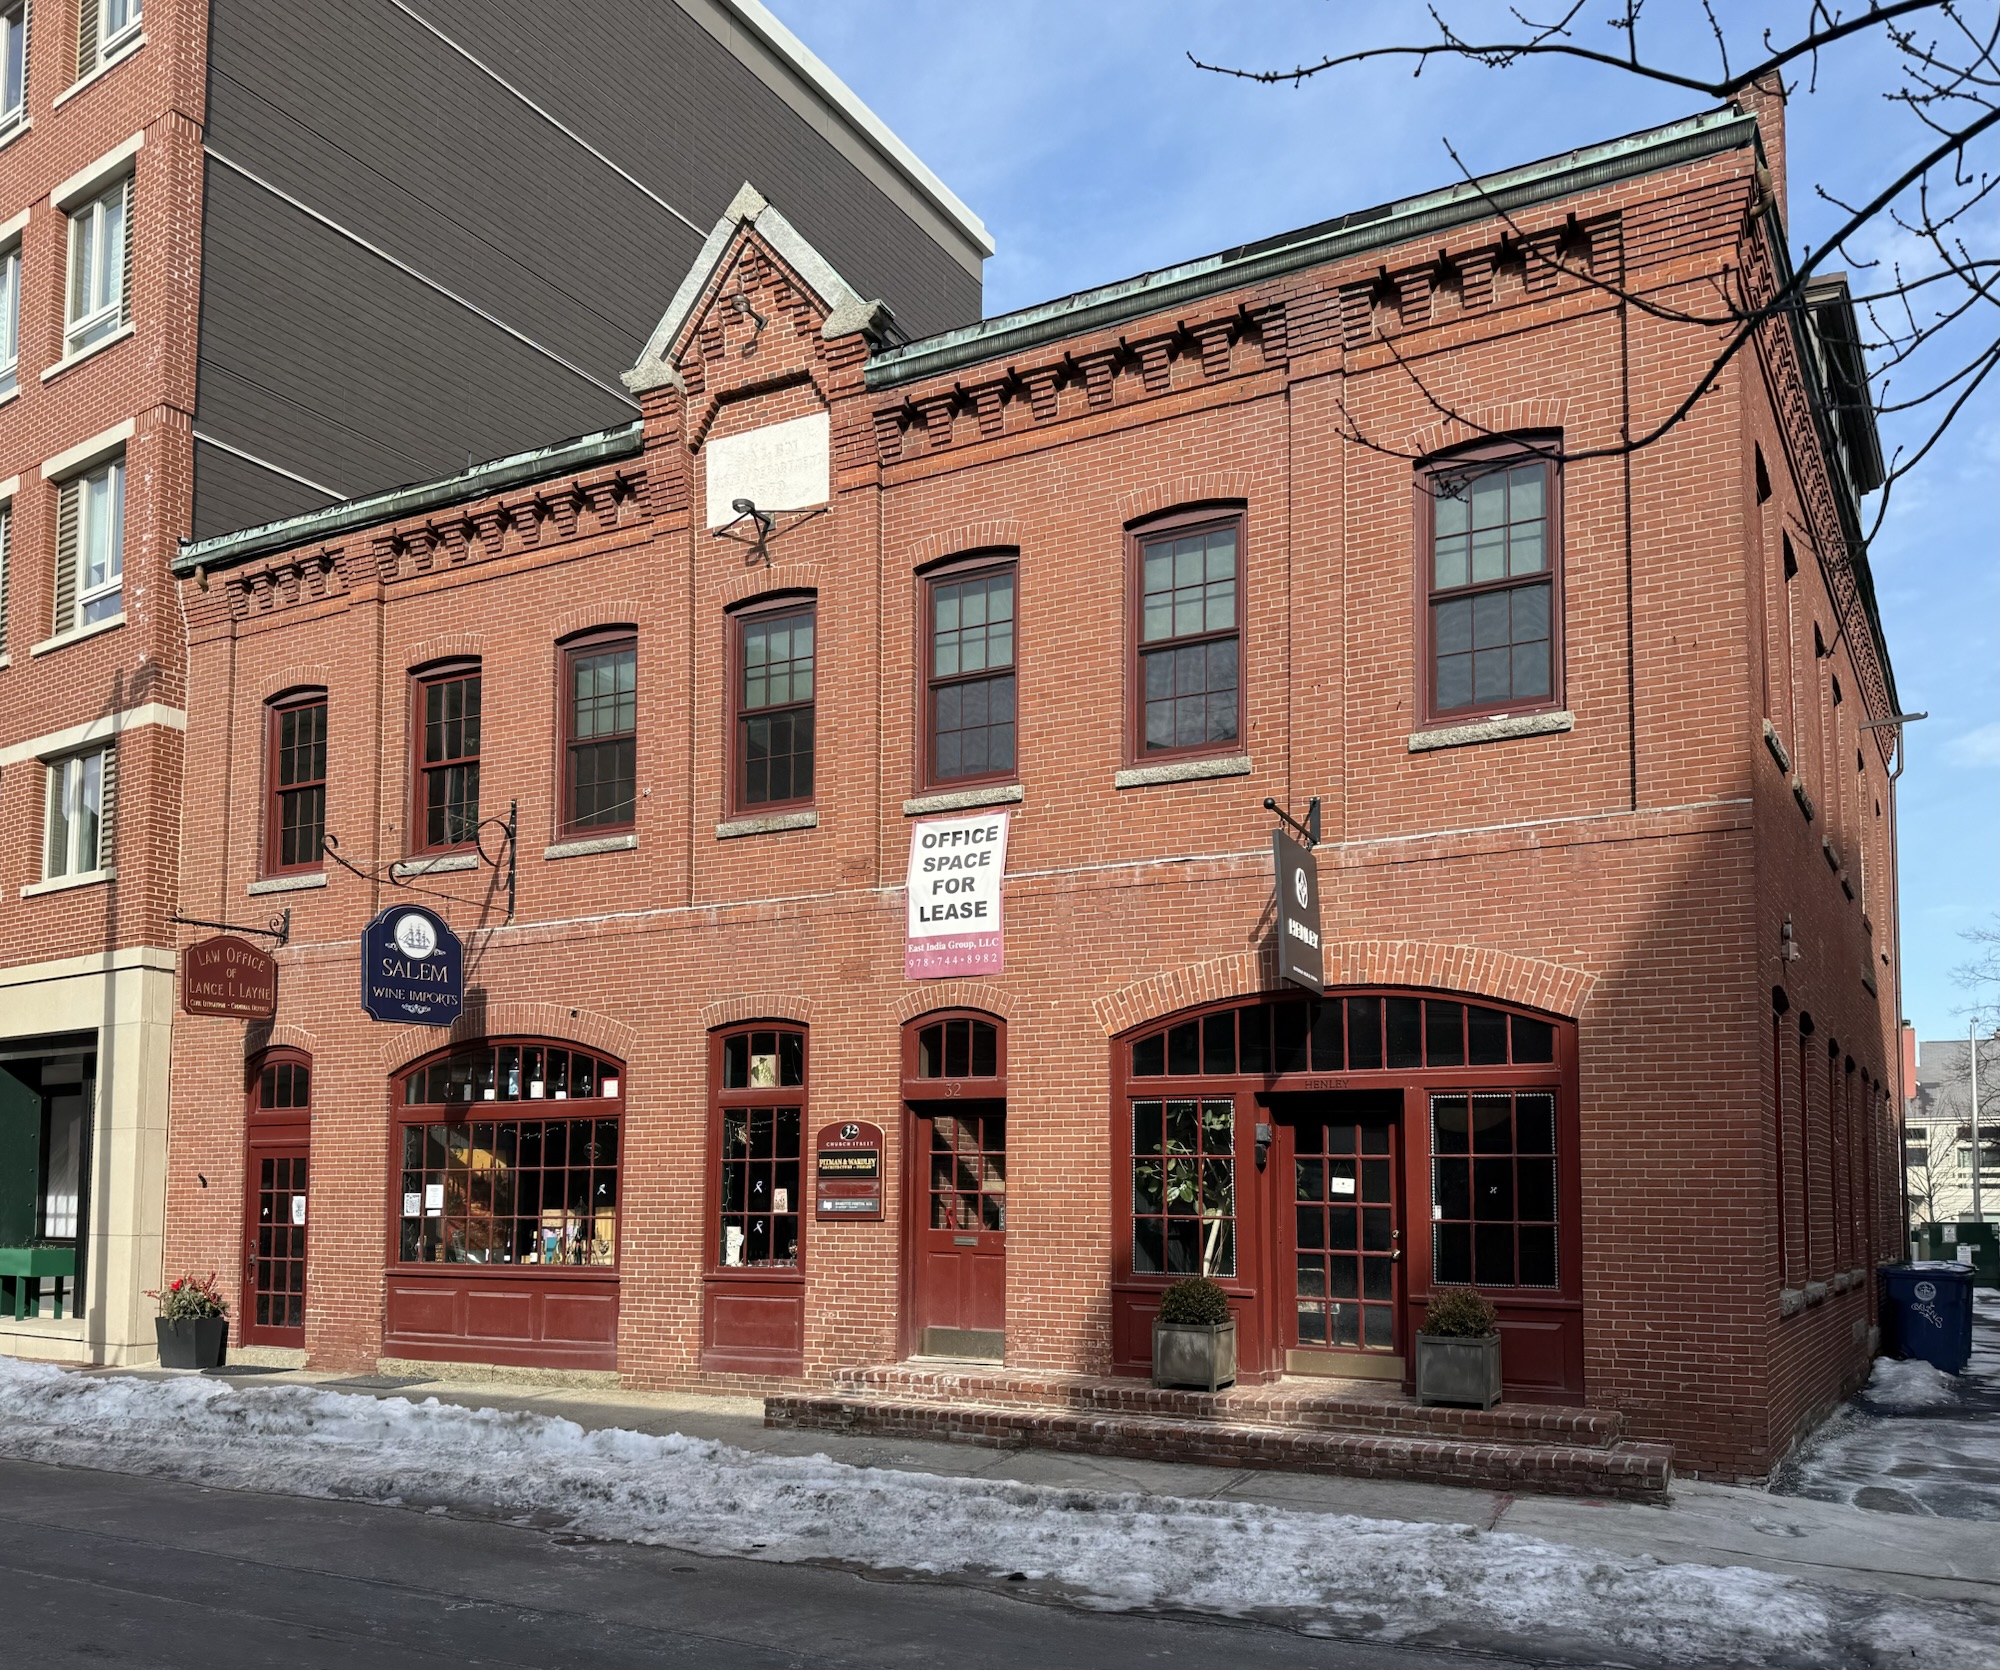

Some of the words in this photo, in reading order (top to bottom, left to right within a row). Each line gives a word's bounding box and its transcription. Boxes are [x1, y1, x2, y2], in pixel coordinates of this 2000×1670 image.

[921, 825, 999, 849] OFFICE
[922, 850, 992, 873] SPACE
[932, 876, 976, 896] FOR
[919, 900, 988, 923] LEASE
[908, 944, 925, 953] East
[926, 941, 946, 952] India
[947, 940, 977, 950] Group,
[978, 937, 999, 948] LLC
[196, 949, 220, 967] LAW
[226, 946, 266, 973] OFFICE
[226, 968, 237, 979] OF
[382, 957, 449, 984] SALEM
[189, 978, 224, 997] LANCE
[228, 981, 235, 998] I.
[239, 982, 271, 1001] LAYNE
[372, 986, 406, 1000] WINE
[409, 990, 458, 1007] IMPORTS
[944, 1082, 961, 1098] 32
[1304, 1079, 1350, 1090] HENLEY
[819, 1158, 843, 1168] PITMAN
